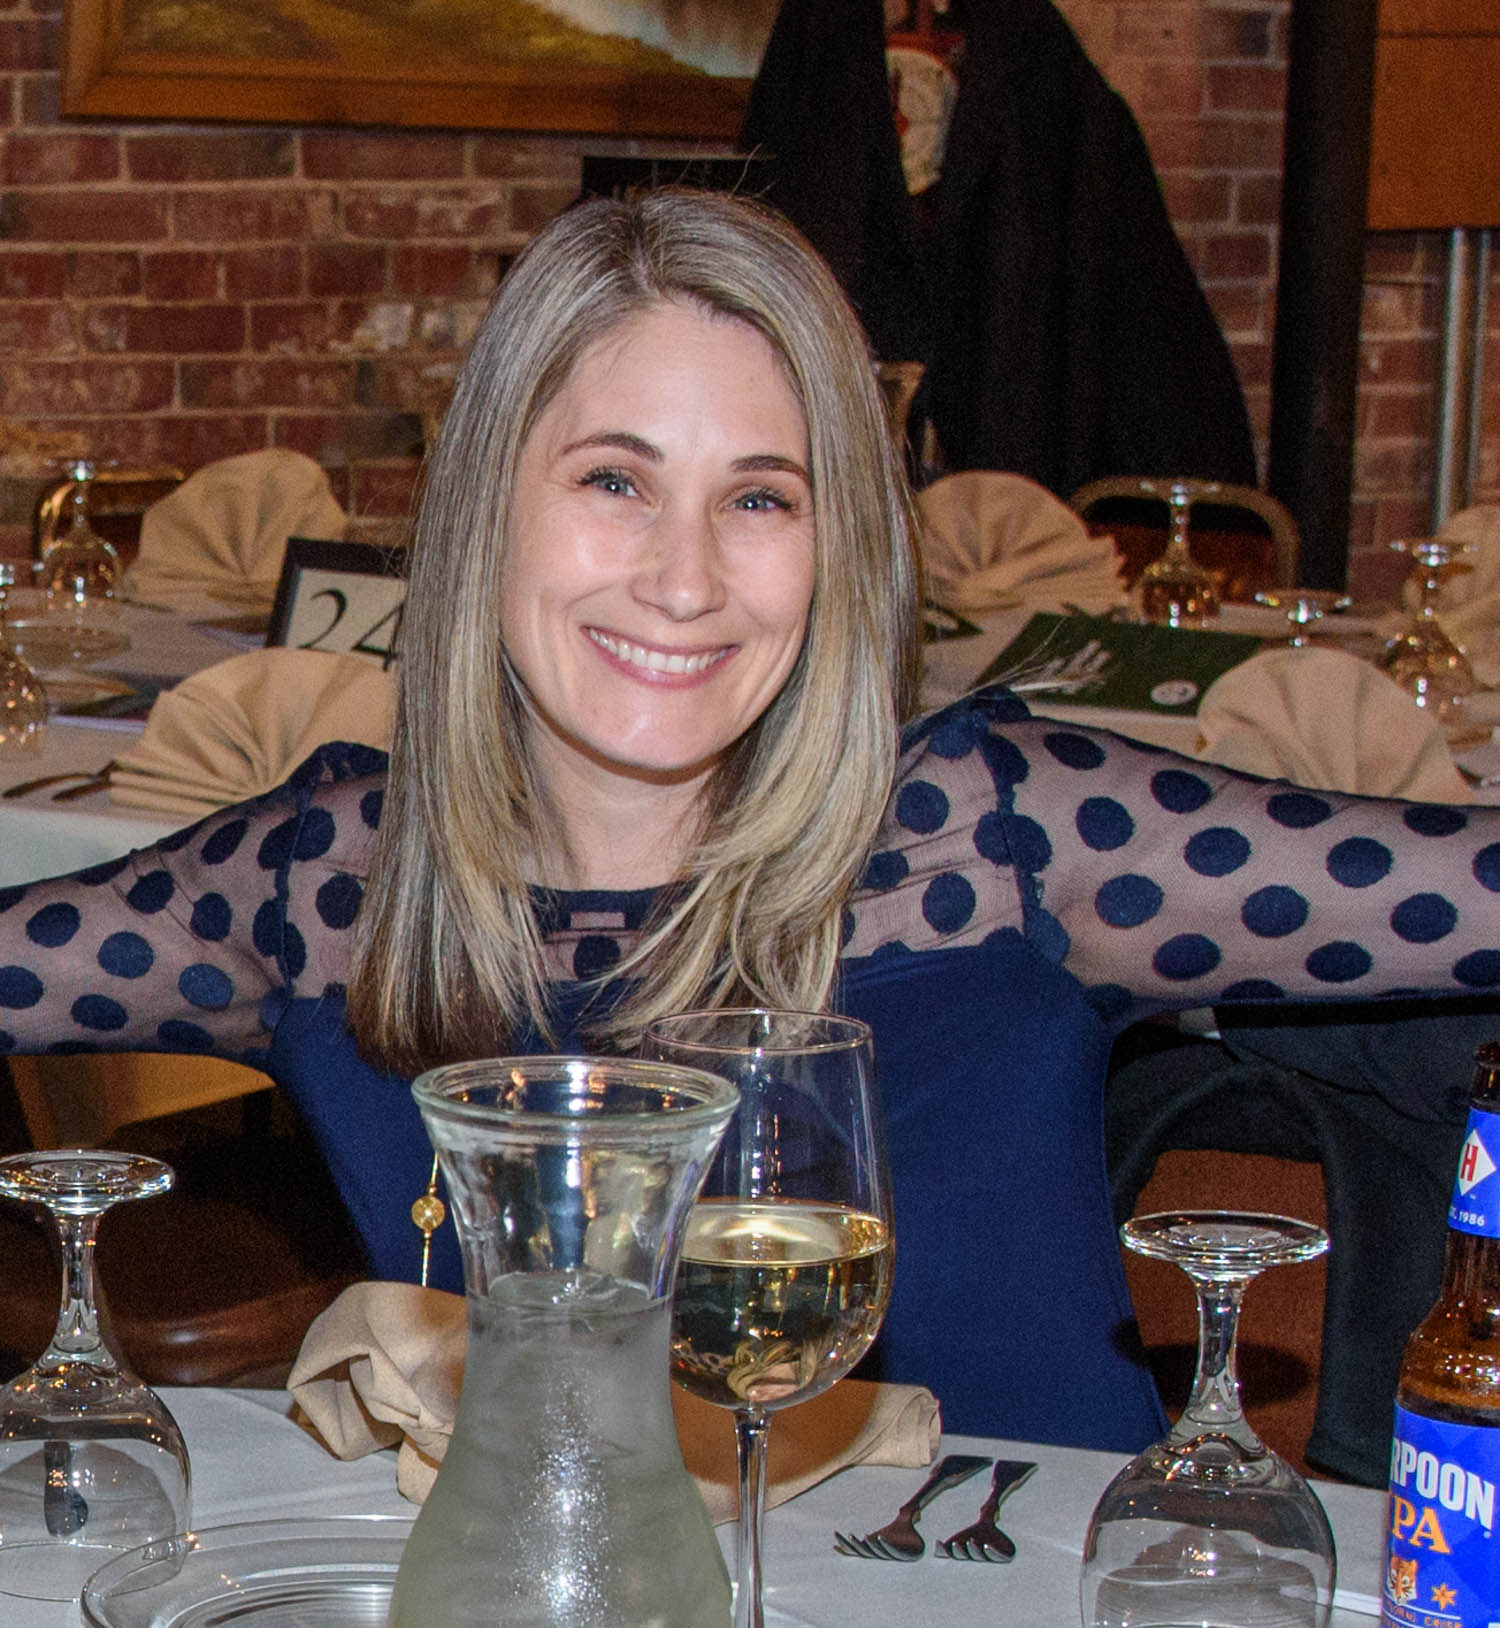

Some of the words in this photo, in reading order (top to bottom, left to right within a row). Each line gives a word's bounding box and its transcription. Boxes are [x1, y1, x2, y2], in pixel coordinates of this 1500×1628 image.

[297, 588, 405, 672] 24
[1461, 1143, 1478, 1182] H
[1459, 1210, 1485, 1227] 1986
[1391, 1437, 1495, 1531] RPOON
[1392, 1495, 1452, 1555] PA
